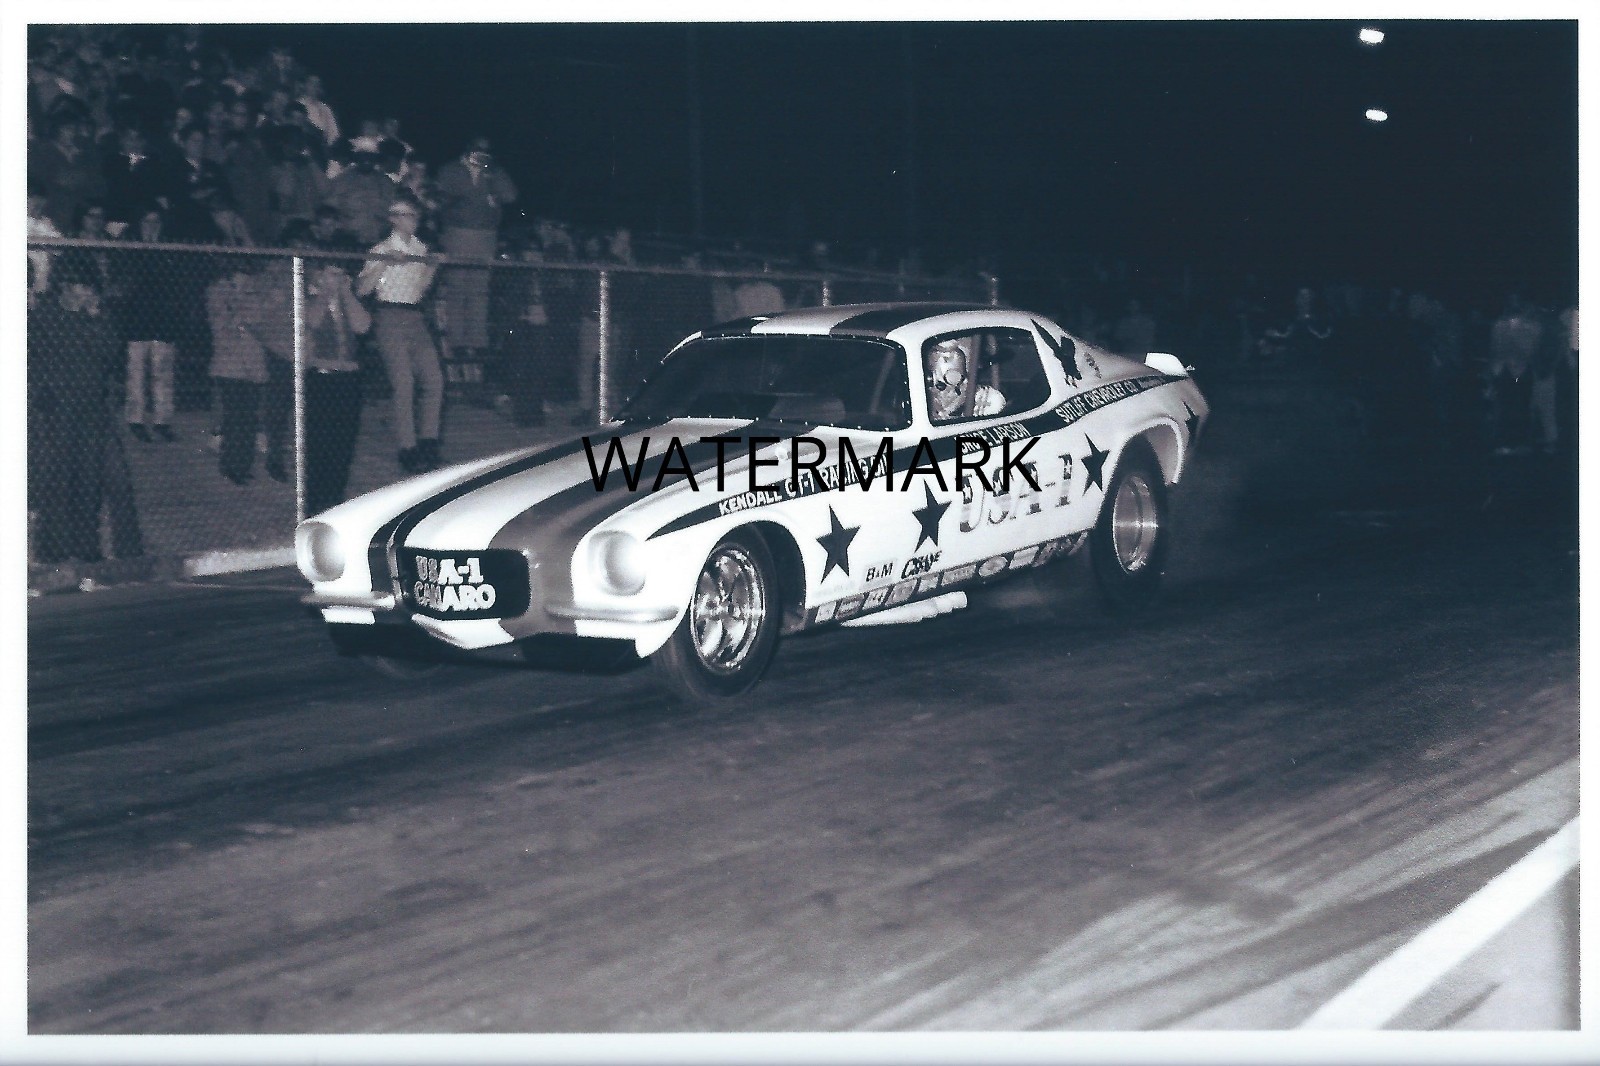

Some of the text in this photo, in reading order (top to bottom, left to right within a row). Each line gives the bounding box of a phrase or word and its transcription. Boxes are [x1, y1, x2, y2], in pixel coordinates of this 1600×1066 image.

[1084, 383, 1127, 408] CHEVROLET
[718, 484, 783, 516] KENDALL
[816, 458, 870, 489] RAING
[415, 555, 484, 585] USA-1
[414, 580, 496, 612] CAMARO
